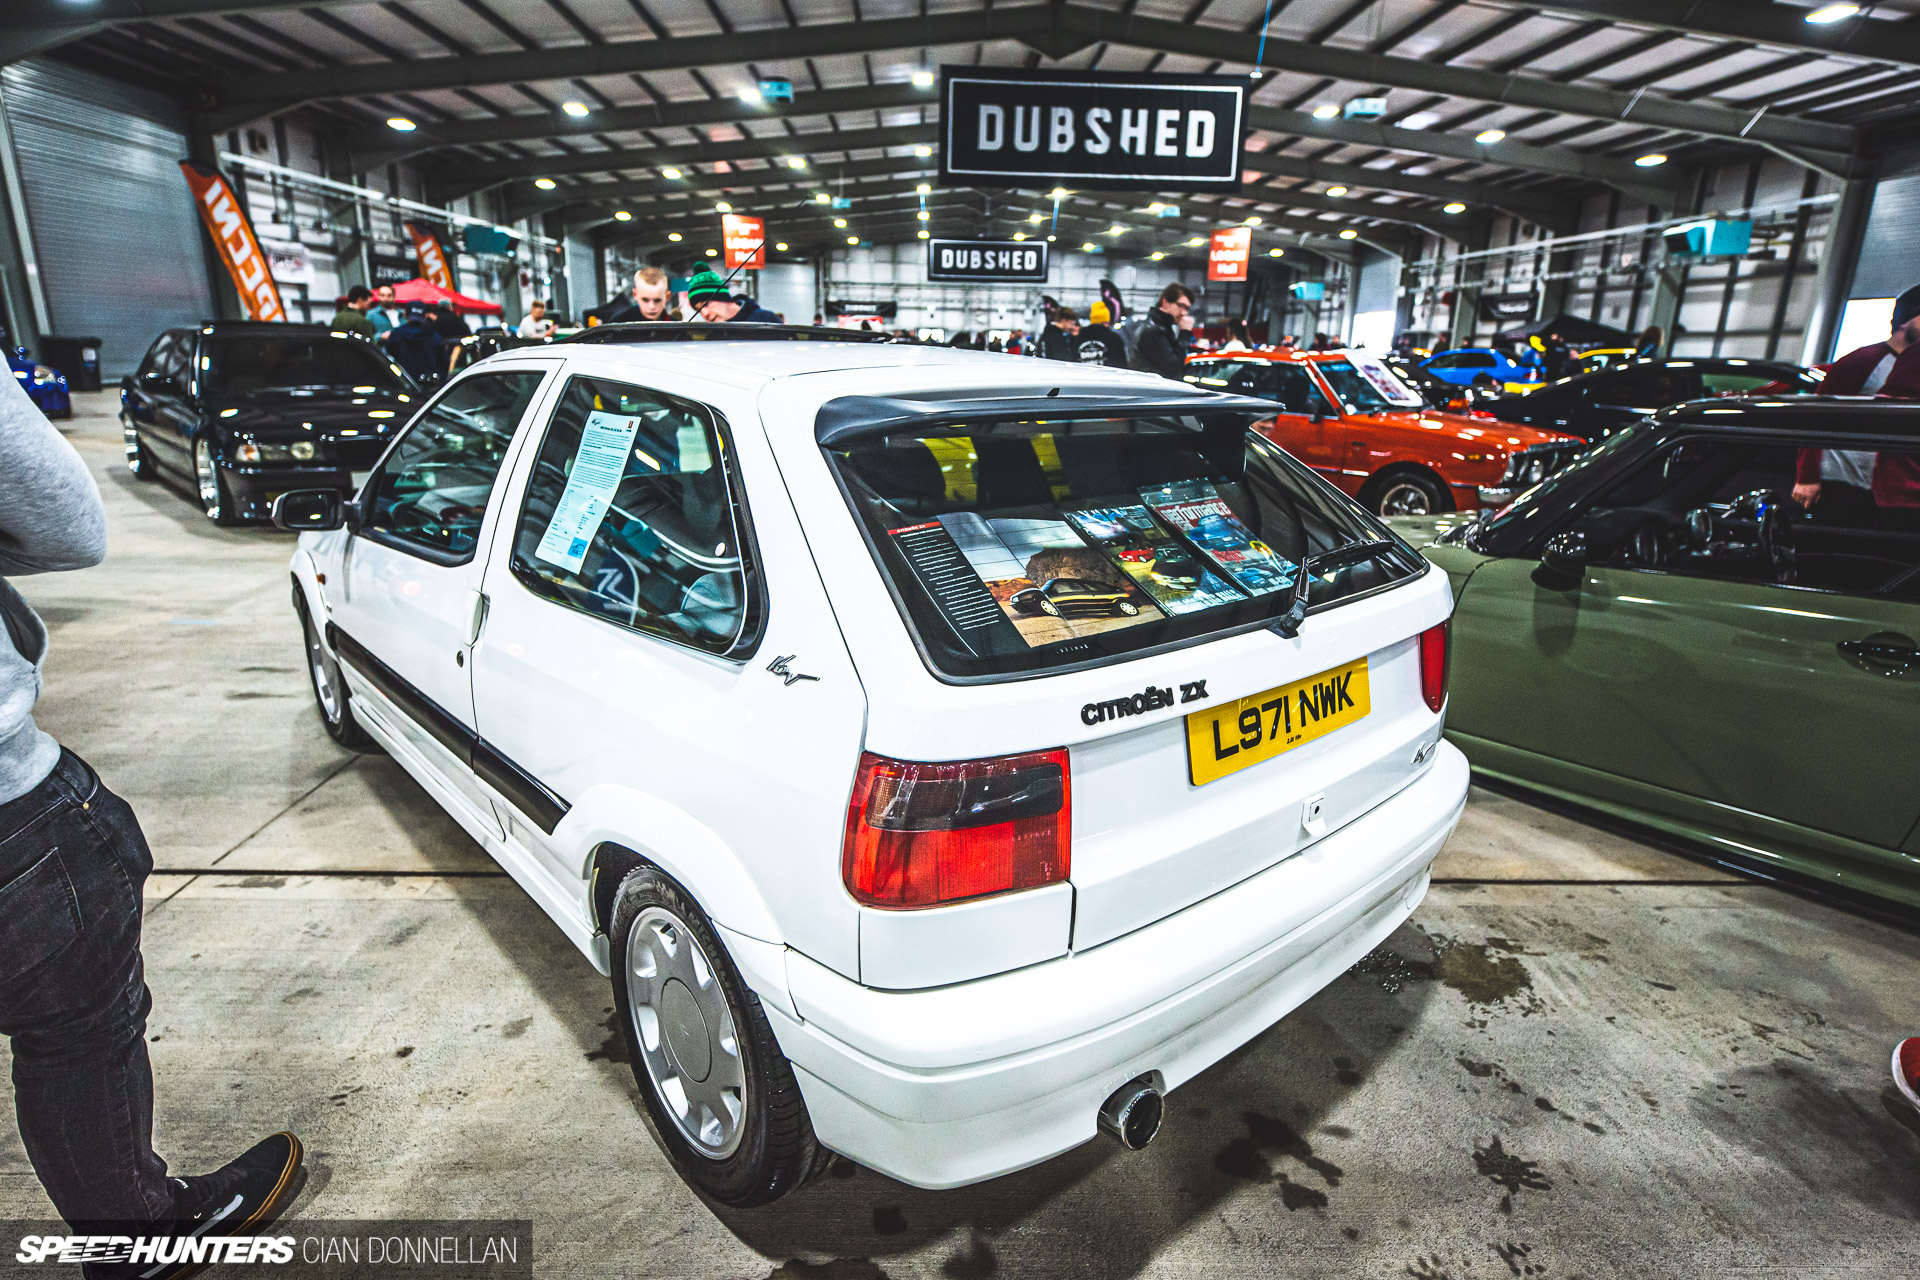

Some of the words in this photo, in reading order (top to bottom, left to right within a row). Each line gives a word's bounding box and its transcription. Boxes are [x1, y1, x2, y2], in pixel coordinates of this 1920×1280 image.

[976, 103, 1218, 159] DUBSHED
[940, 248, 1038, 271] DUBSHED
[1081, 687, 1174, 726] CITROËN
[1180, 679, 1209, 704] ZX
[1212, 696, 1292, 761] L971
[1298, 671, 1355, 728] NWK
